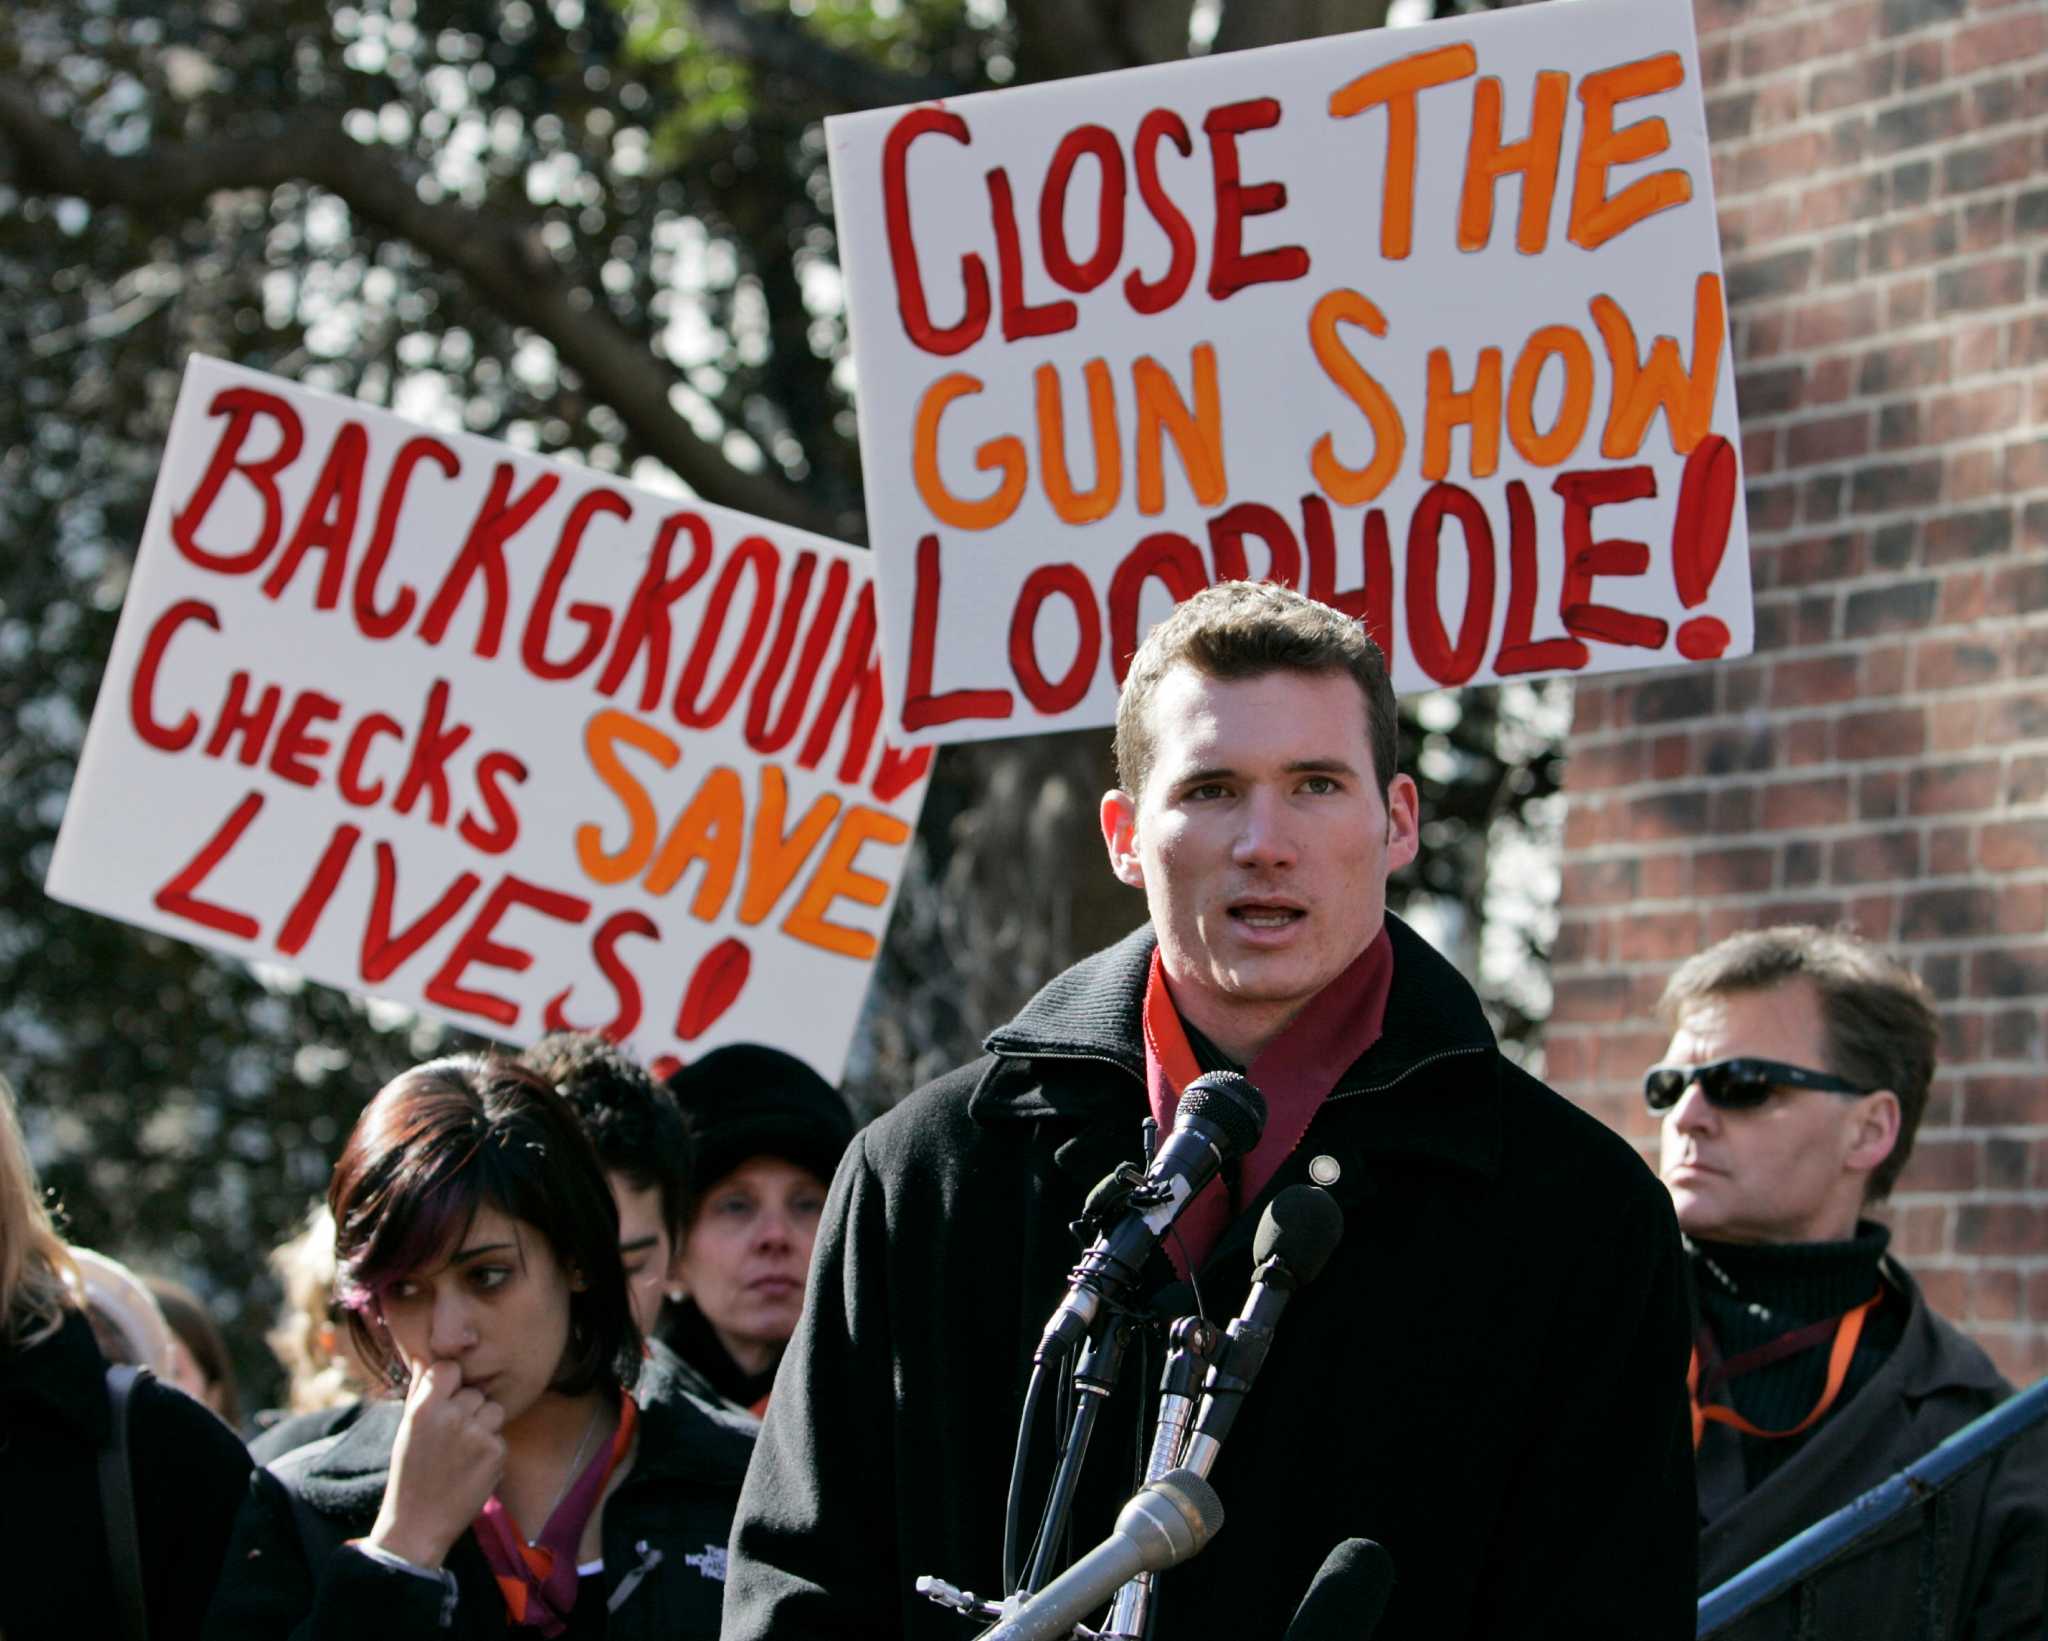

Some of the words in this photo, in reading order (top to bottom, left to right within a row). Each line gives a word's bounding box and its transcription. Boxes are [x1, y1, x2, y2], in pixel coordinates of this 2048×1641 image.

[882, 97, 1311, 357] CLOSE
[1329, 42, 1692, 261] THE
[912, 342, 1228, 531] GUN
[1308, 272, 1726, 506] SHOW
[153, 791, 753, 1082] LIVES!
[576, 709, 911, 962] SAVE
